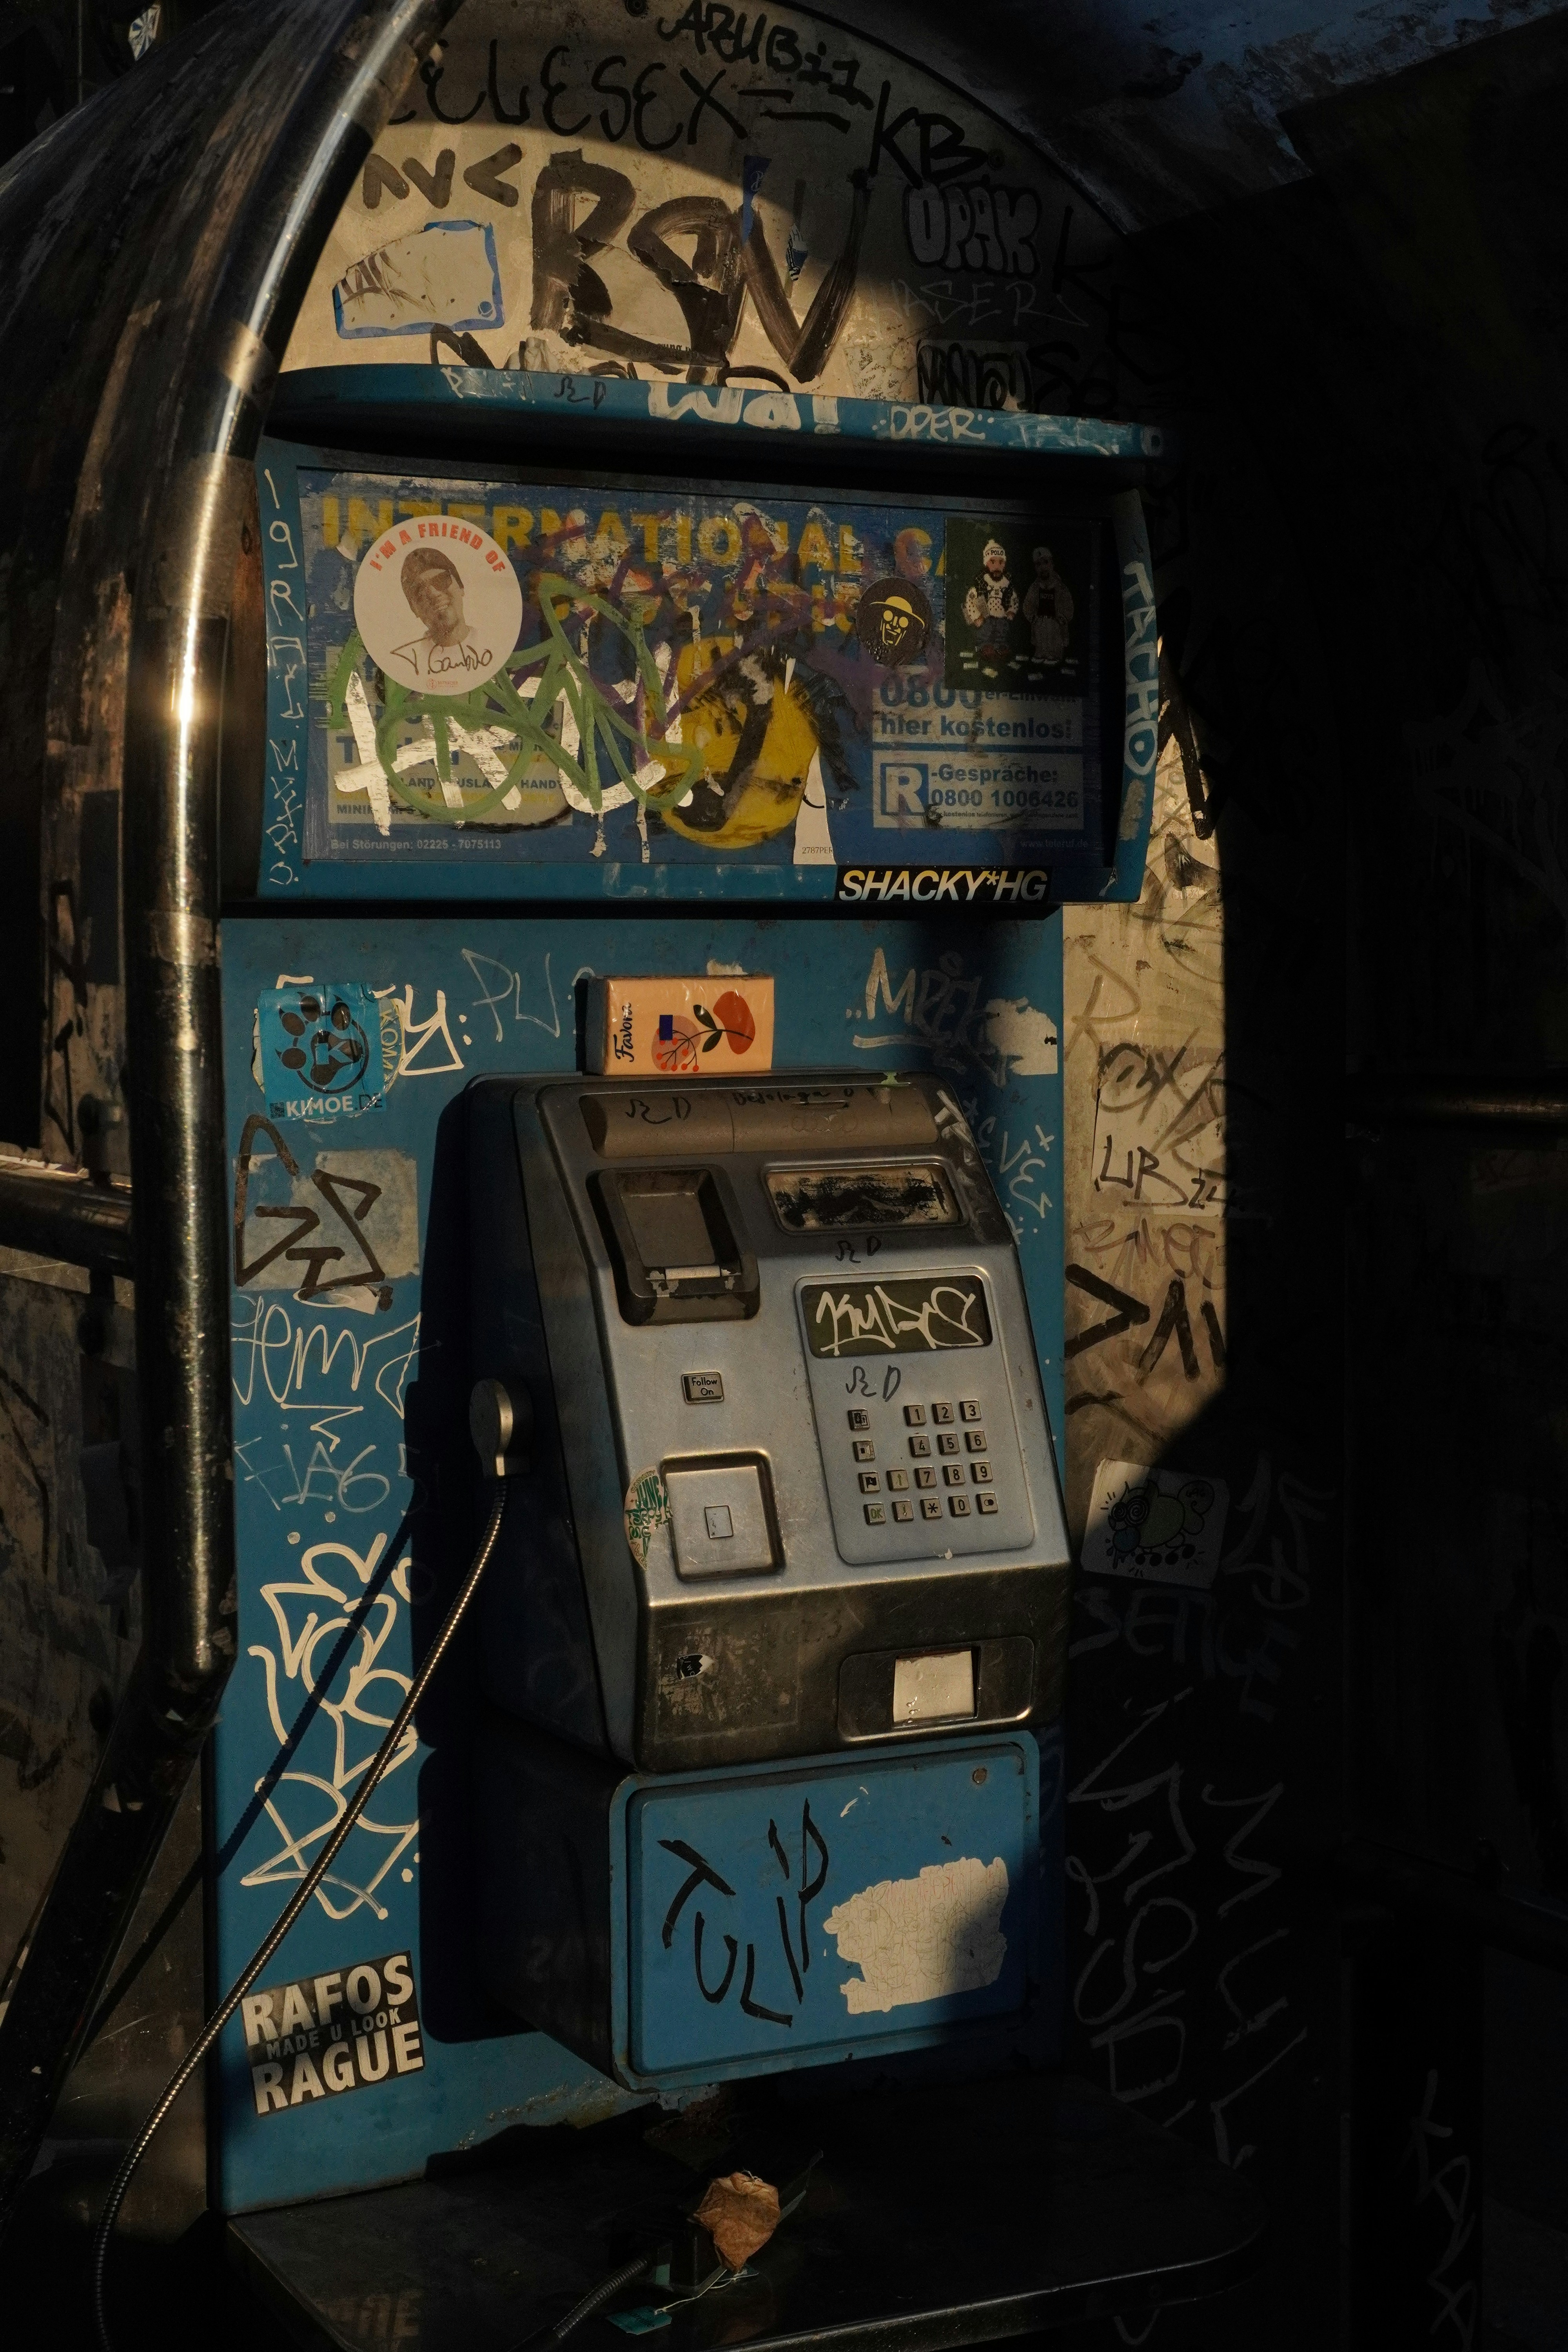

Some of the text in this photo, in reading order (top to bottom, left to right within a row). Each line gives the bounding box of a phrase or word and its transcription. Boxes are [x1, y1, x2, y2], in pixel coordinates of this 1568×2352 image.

[370, 522, 506, 573] I'M A FRIEND OF
[880, 714, 932, 735] hier
[931, 788, 1079, 808] 0800 1006426
[331, 839, 349, 850] Bei
[352, 839, 414, 851] Störungen:
[417, 840, 448, 849] 02225
[459, 840, 501, 850] 7075113
[286, 1094, 383, 1117] KIMOE.DE
[691, 1376, 718, 1387] Follow
[701, 1387, 714, 1397] On
[914, 1408, 920, 1421] 1
[942, 1406, 949, 1419] 2
[969, 1404, 976, 1417] 3
[919, 1439, 926, 1451] 4
[947, 1437, 955, 1449] 5
[975, 1434, 982, 1446] 6
[924, 1470, 931, 1483] 7
[953, 1468, 960, 1481] 8
[980, 1466, 988, 1478] 9
[958, 1499, 965, 1511] 0
[870, 1508, 883, 1519] OK
[241, 1955, 413, 2047] RAFOS
[266, 2007, 402, 2060] MADE U LOOK
[252, 2020, 424, 2115] RAGUE
